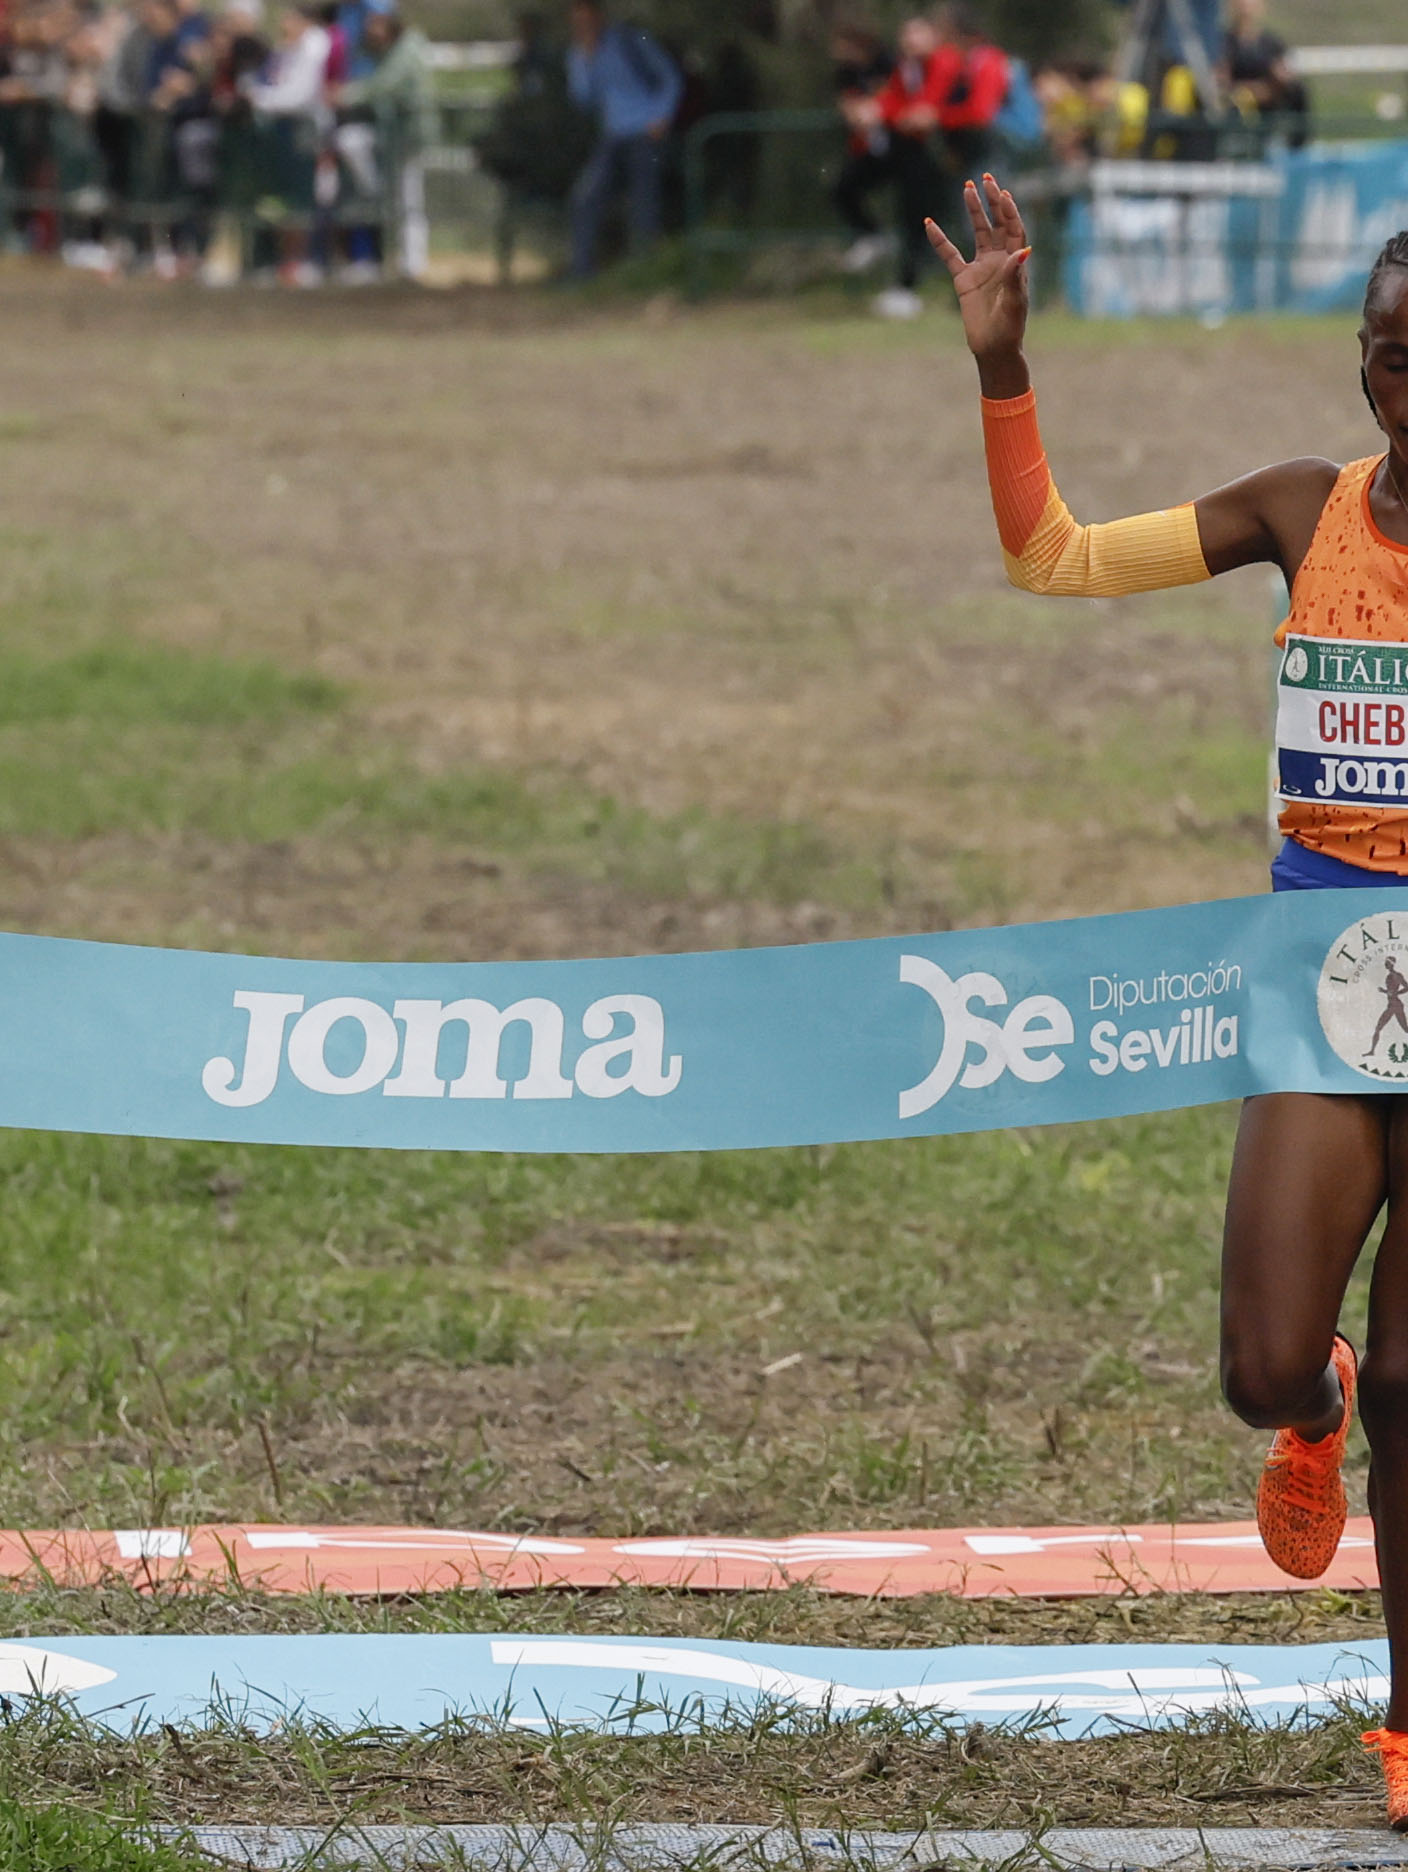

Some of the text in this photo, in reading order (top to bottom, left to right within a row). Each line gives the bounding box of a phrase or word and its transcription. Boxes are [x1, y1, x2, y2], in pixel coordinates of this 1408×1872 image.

[1088, 959, 1242, 1016] Diputación
[1352, 954, 1373, 984] CROSS
[1088, 1005, 1239, 1077] Sevilla
